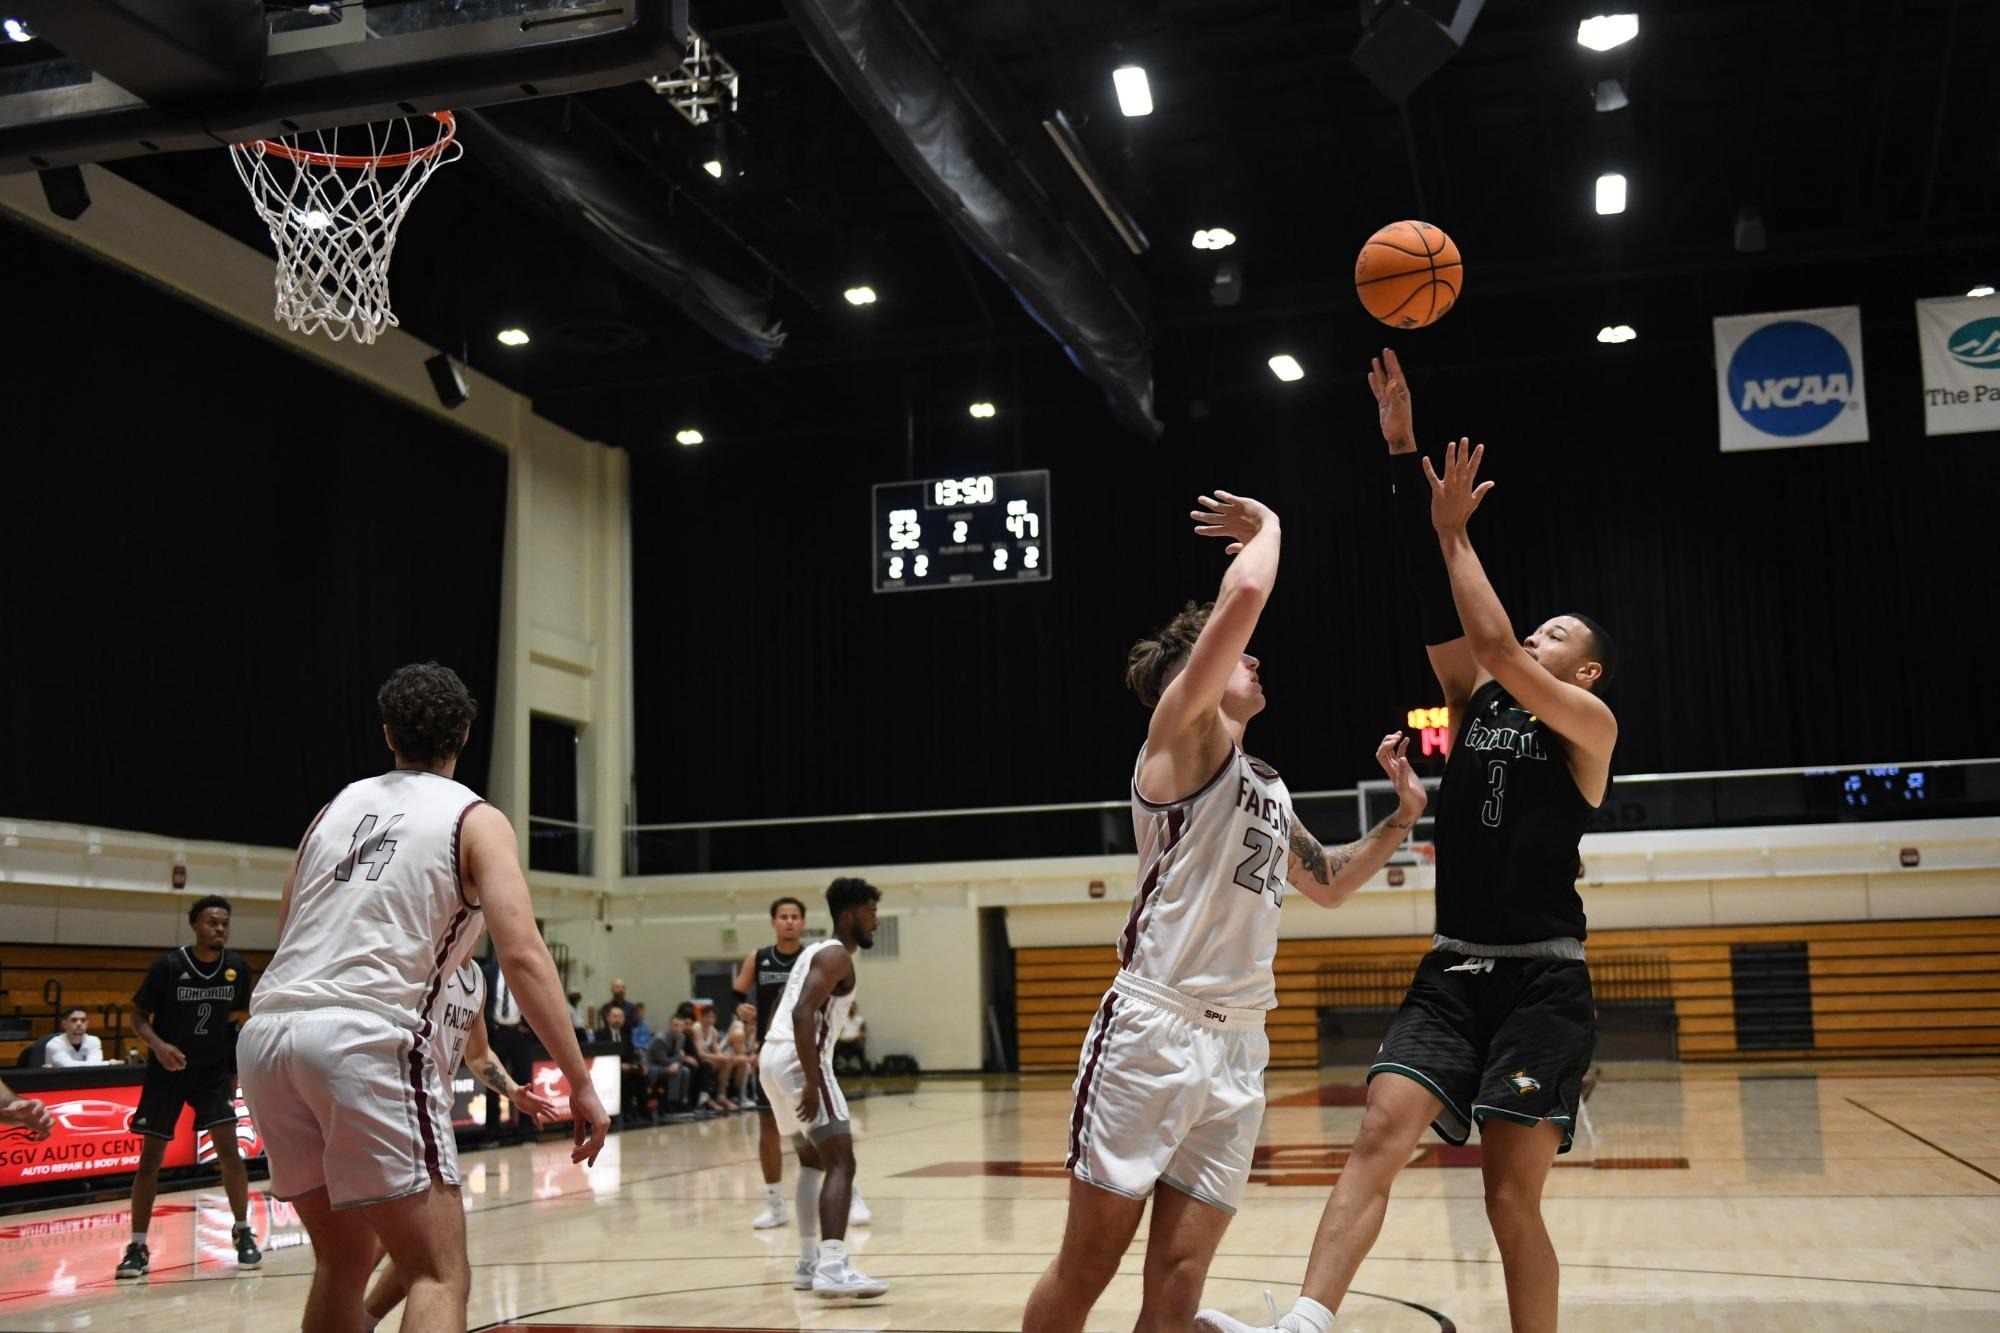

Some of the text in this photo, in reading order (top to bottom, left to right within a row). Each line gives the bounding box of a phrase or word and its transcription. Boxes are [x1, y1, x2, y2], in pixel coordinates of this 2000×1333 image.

[1741, 373, 1850, 411] NCAA
[1925, 388, 1970, 406] The
[935, 476, 994, 506] 13:50
[1482, 760, 1507, 827] 3
[335, 813, 404, 882] 14
[194, 1003, 211, 1035] 2
[1203, 1009, 1227, 1023] SPU
[21, 1165, 50, 1177] AUTO
[51, 1161, 83, 1173] REPAIR
[85, 1161, 92, 1170] &
[93, 1157, 119, 1170] BODY
[42, 1143, 96, 1162] AUTO
